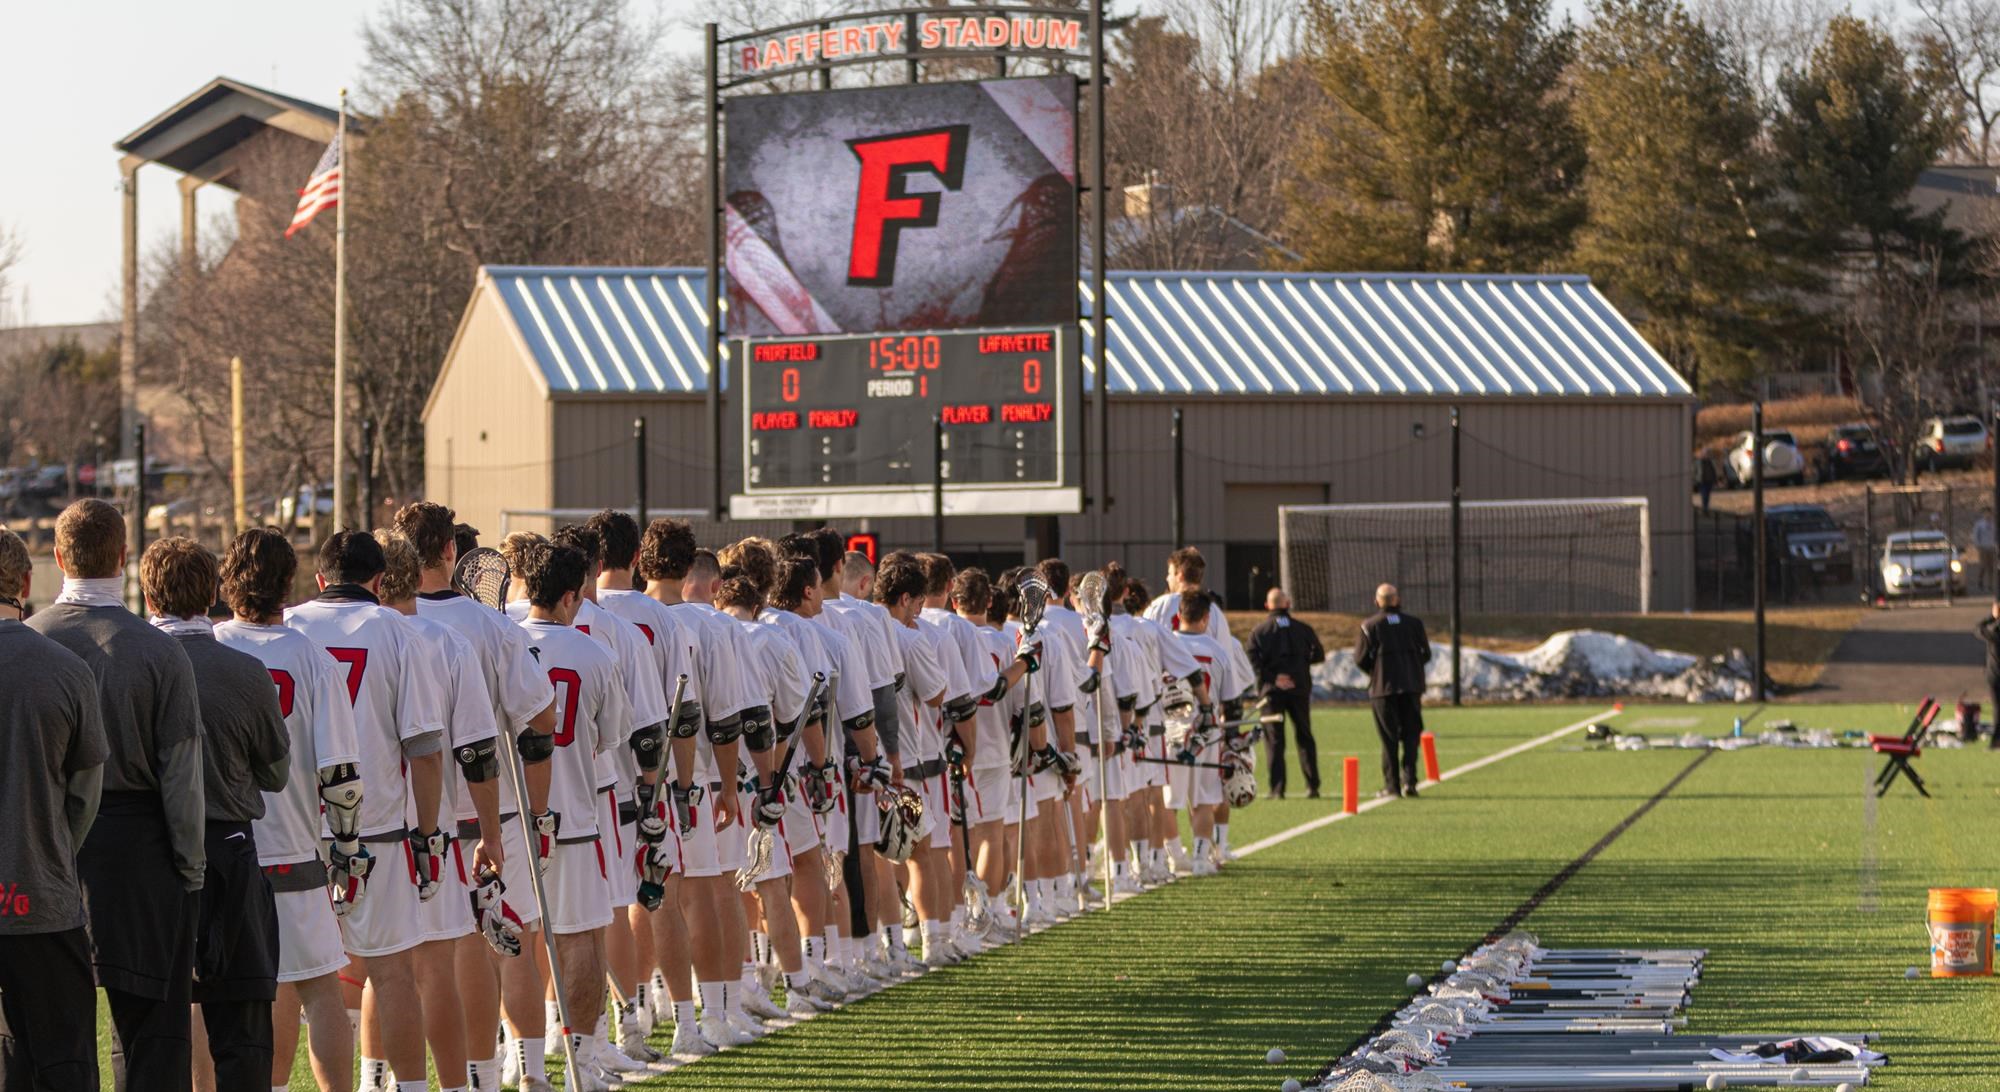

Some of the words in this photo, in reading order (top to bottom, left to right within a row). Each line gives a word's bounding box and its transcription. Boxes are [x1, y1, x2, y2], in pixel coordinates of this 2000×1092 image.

[741, 21, 903, 72] RAFFERTY
[920, 16, 1081, 50] STADIUM
[844, 124, 970, 287] F
[754, 342, 817, 362] FAIRFIELD
[869, 335, 941, 371] 15:00
[979, 332, 1050, 354] LAFAYETTE
[782, 368, 800, 402] 0
[867, 379, 914, 397] PERIOD
[919, 375, 928, 398] 1
[1023, 358, 1041, 394] 0
[752, 411, 798, 431] PLAYER
[808, 409, 857, 429] PENALTY
[942, 404, 990, 424] PLAYER
[1001, 402, 1052, 423] PENALTY
